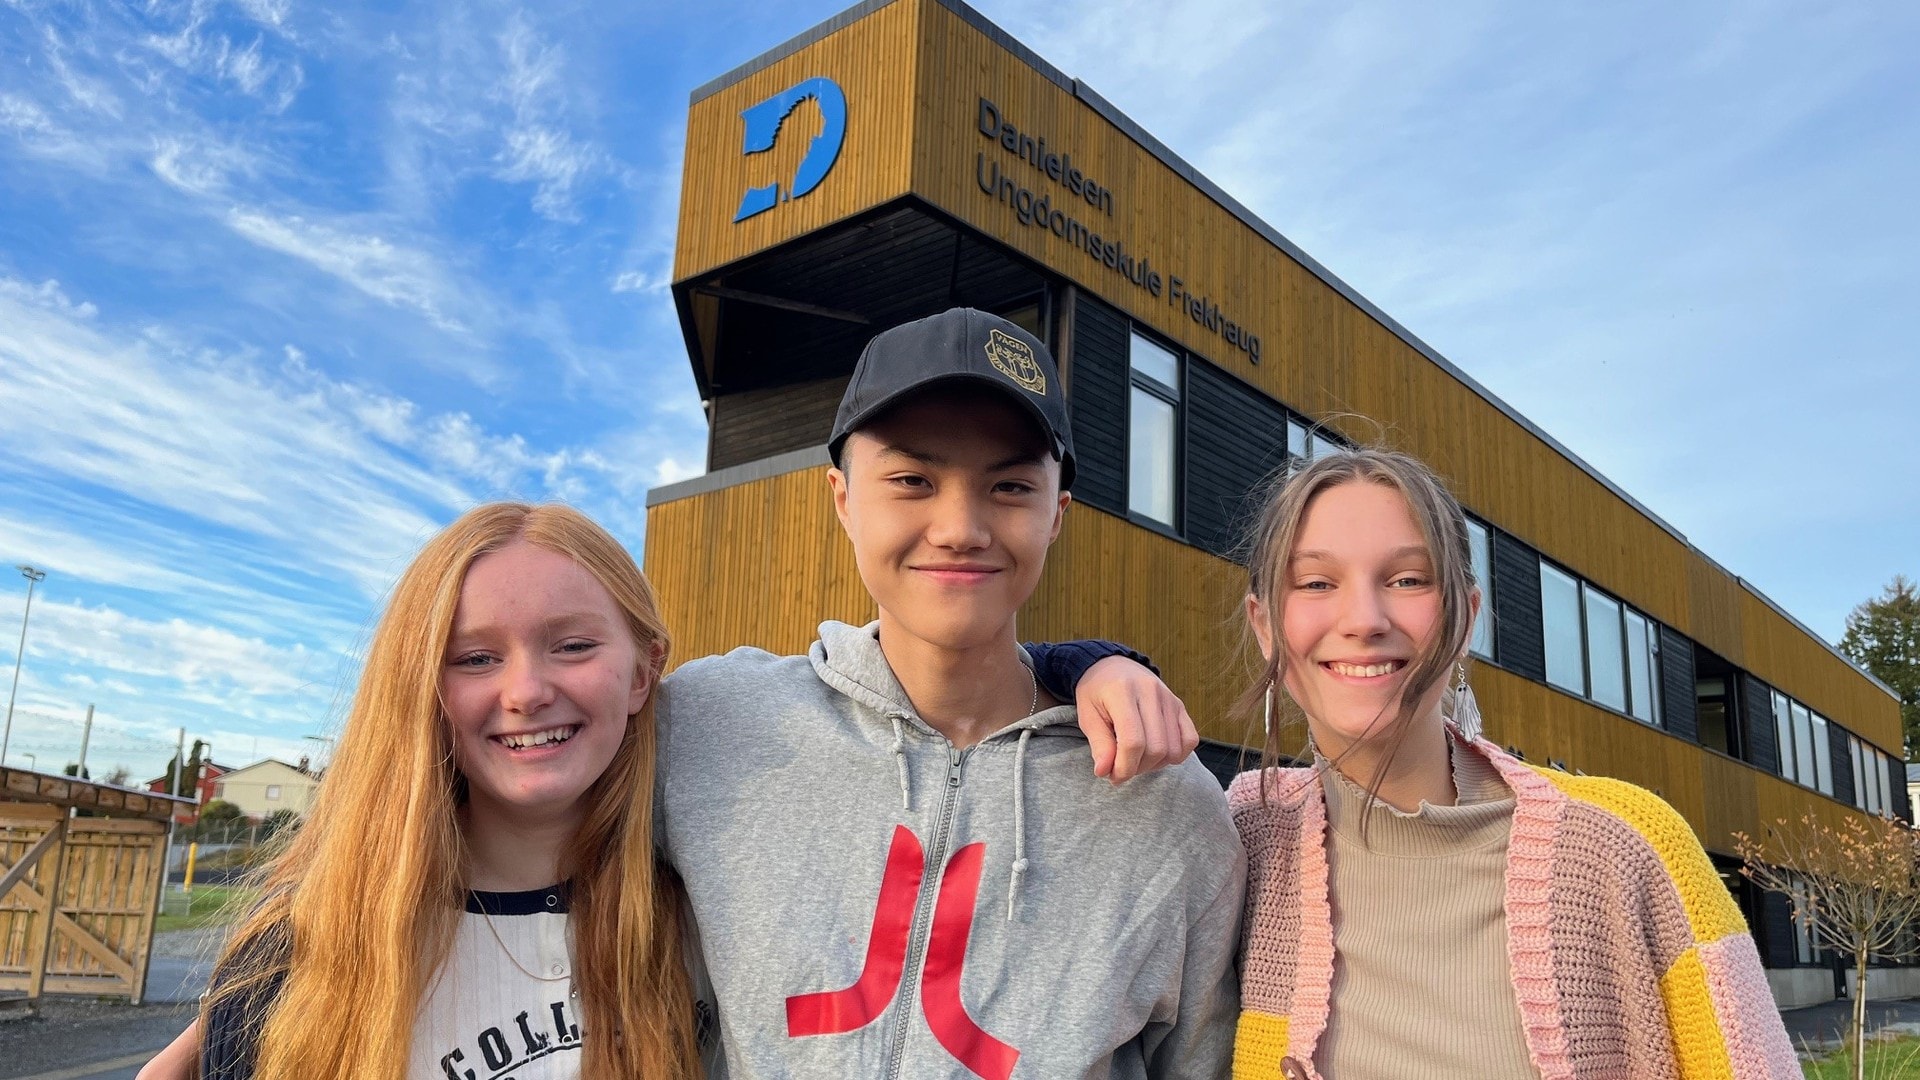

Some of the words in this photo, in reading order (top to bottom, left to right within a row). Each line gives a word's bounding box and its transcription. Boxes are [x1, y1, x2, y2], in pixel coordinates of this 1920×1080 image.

[978, 97, 1113, 216] Danielsen
[977, 152, 1162, 297] Ungdomsskule
[1168, 274, 1261, 366] Frekhaug
